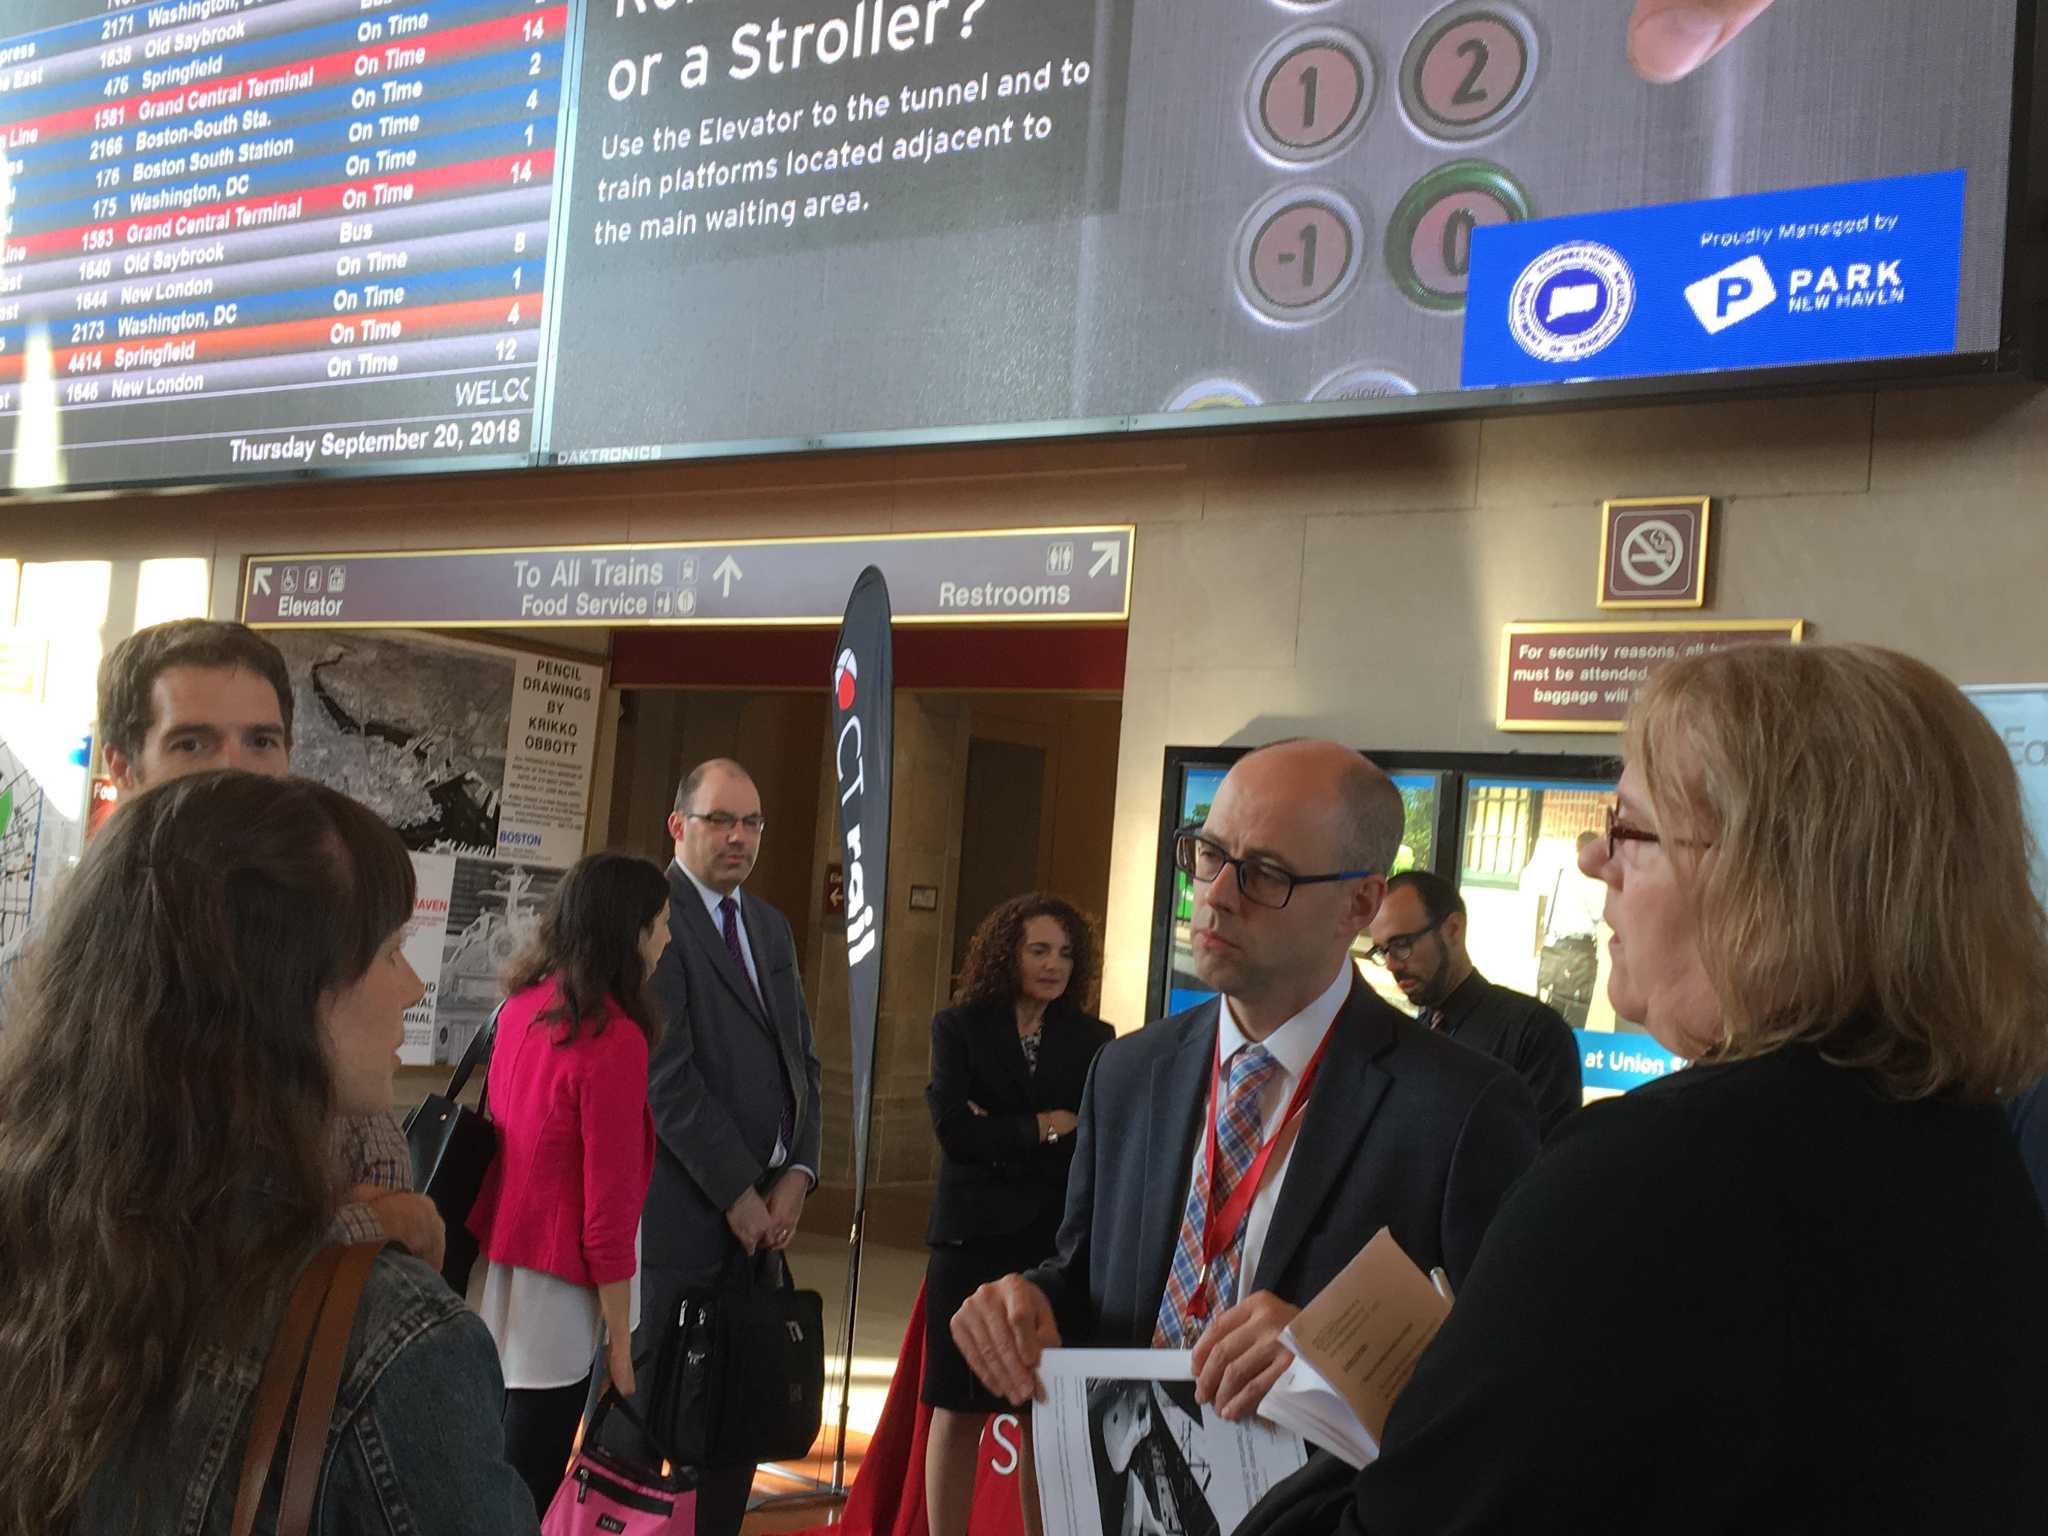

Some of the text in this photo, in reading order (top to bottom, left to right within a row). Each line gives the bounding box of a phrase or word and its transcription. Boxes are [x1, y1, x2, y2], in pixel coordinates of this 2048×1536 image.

[101, 15, 134, 40] 2171
[145, 37, 170, 59] Old
[174, 20, 246, 53] Saybrook
[104, 13, 429, 97] 476 Springfield On Time
[607, 0, 985, 102] or a Stroller?
[10, 127, 38, 148] Line
[94, 106, 125, 131] 1581
[138, 95, 183, 121] Grand
[187, 82, 242, 108] Central
[247, 66, 314, 100] Terminal
[354, 55, 379, 77] On
[385, 47, 426, 70] Time
[522, 16, 545, 42] 14
[1298, 38, 1490, 128] 1 2
[90, 136, 123, 161] 2166
[136, 115, 239, 151] Boston-South
[242, 110, 272, 131] Sta.
[351, 88, 376, 110] On
[382, 80, 423, 103] Time
[528, 51, 542, 76] 2
[601, 56, 1091, 161] Use the Elevator to the tunnel and to
[96, 88, 539, 188] 176 Boston South Station On Time 4
[597, 110, 1052, 203] train platforms located adjacent to
[92, 124, 534, 220] 175 Washington, DC On Time 1
[81, 231, 114, 252] 1583
[126, 220, 171, 244] Grand
[176, 209, 230, 235] Central
[235, 198, 302, 228] Terminal
[342, 189, 367, 210] On
[373, 183, 414, 204] Time
[511, 159, 533, 184] 14
[594, 190, 870, 247] the main waiting area.
[1701, 211, 1900, 248] Proudly Managed by
[75, 289, 108, 312] 1644
[120, 286, 152, 305] New
[156, 277, 213, 300] London
[336, 254, 361, 276] On
[367, 250, 408, 274] Time
[515, 231, 527, 253] 8
[79, 260, 111, 282] 1640
[124, 253, 149, 275] Old
[153, 242, 225, 273] Saybrook
[339, 222, 373, 244] Bus
[1277, 223, 1318, 288] -1
[1716, 276, 1754, 319] P
[1789, 259, 1902, 295] PARK
[71, 267, 523, 344] 2173 Washington, DC On Time 1
[1788, 287, 1905, 314] NEW HAVEN
[68, 302, 521, 373] 4414 Springfield On Time 4
[67, 337, 518, 404] 1646 New London On Time 12
[230, 418, 521, 463] Thursday September 20, 2018
[557, 445, 662, 465] DAKTRONICS
[513, 556, 665, 590] To All Trains
[939, 581, 1072, 608] Restrooms
[278, 595, 344, 618] Elevator
[521, 592, 648, 617] Food Service
[536, 658, 582, 681] PENCIL
[1513, 667, 1550, 681] must
[1555, 666, 1575, 682] be
[1518, 644, 1544, 660] For
[1548, 643, 1609, 662] security
[522, 676, 592, 702] DRAWINGS
[546, 700, 565, 715] BY
[1533, 687, 1599, 706] baggage
[1604, 687, 1629, 702] will
[525, 734, 577, 756] OBBOTT
[528, 716, 578, 737] KRIKKO
[500, 830, 542, 846] BOSTON
[837, 715, 876, 968] CT rail
[1584, 1049, 1604, 1070] at
[1609, 1050, 1665, 1076] Union
[991, 1413, 1019, 1476] S
